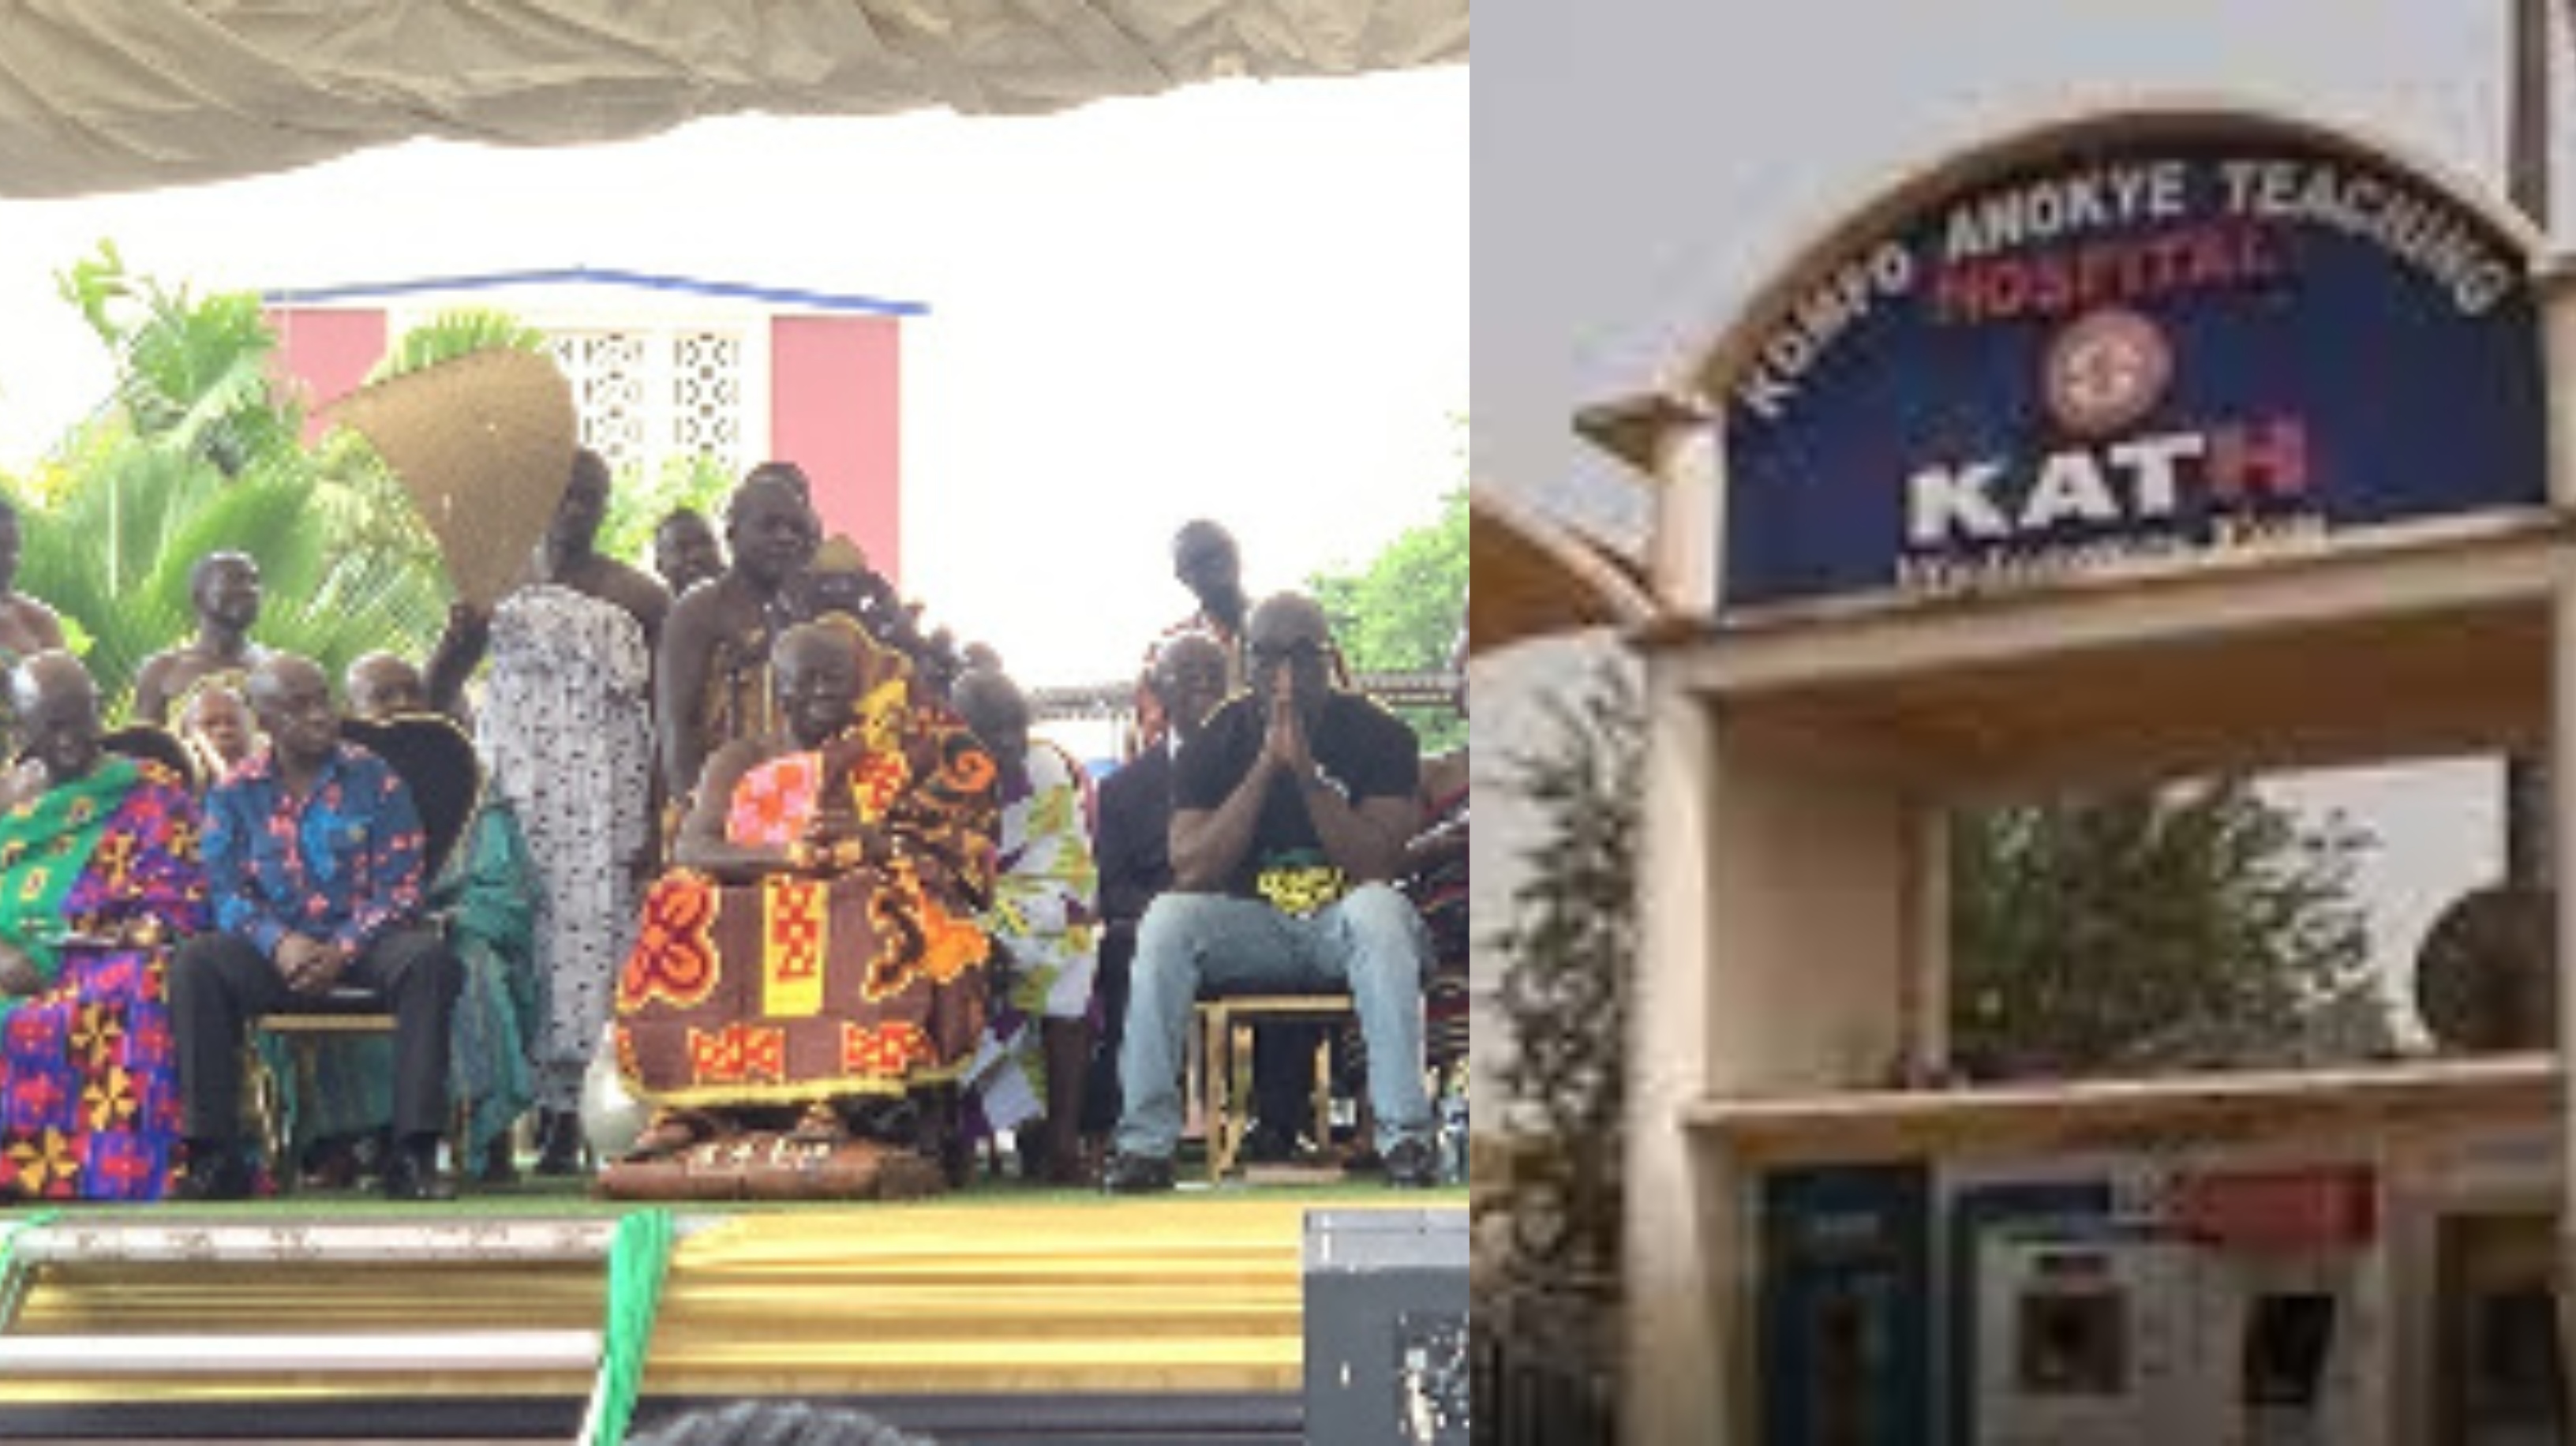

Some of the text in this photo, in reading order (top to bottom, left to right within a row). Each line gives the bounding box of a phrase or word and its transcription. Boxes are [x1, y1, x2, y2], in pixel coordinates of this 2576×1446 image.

[1946, 163, 2186, 262] ANOKYE
[2219, 163, 2510, 314] TEACHING
[1907, 420, 2306, 545] KATH
